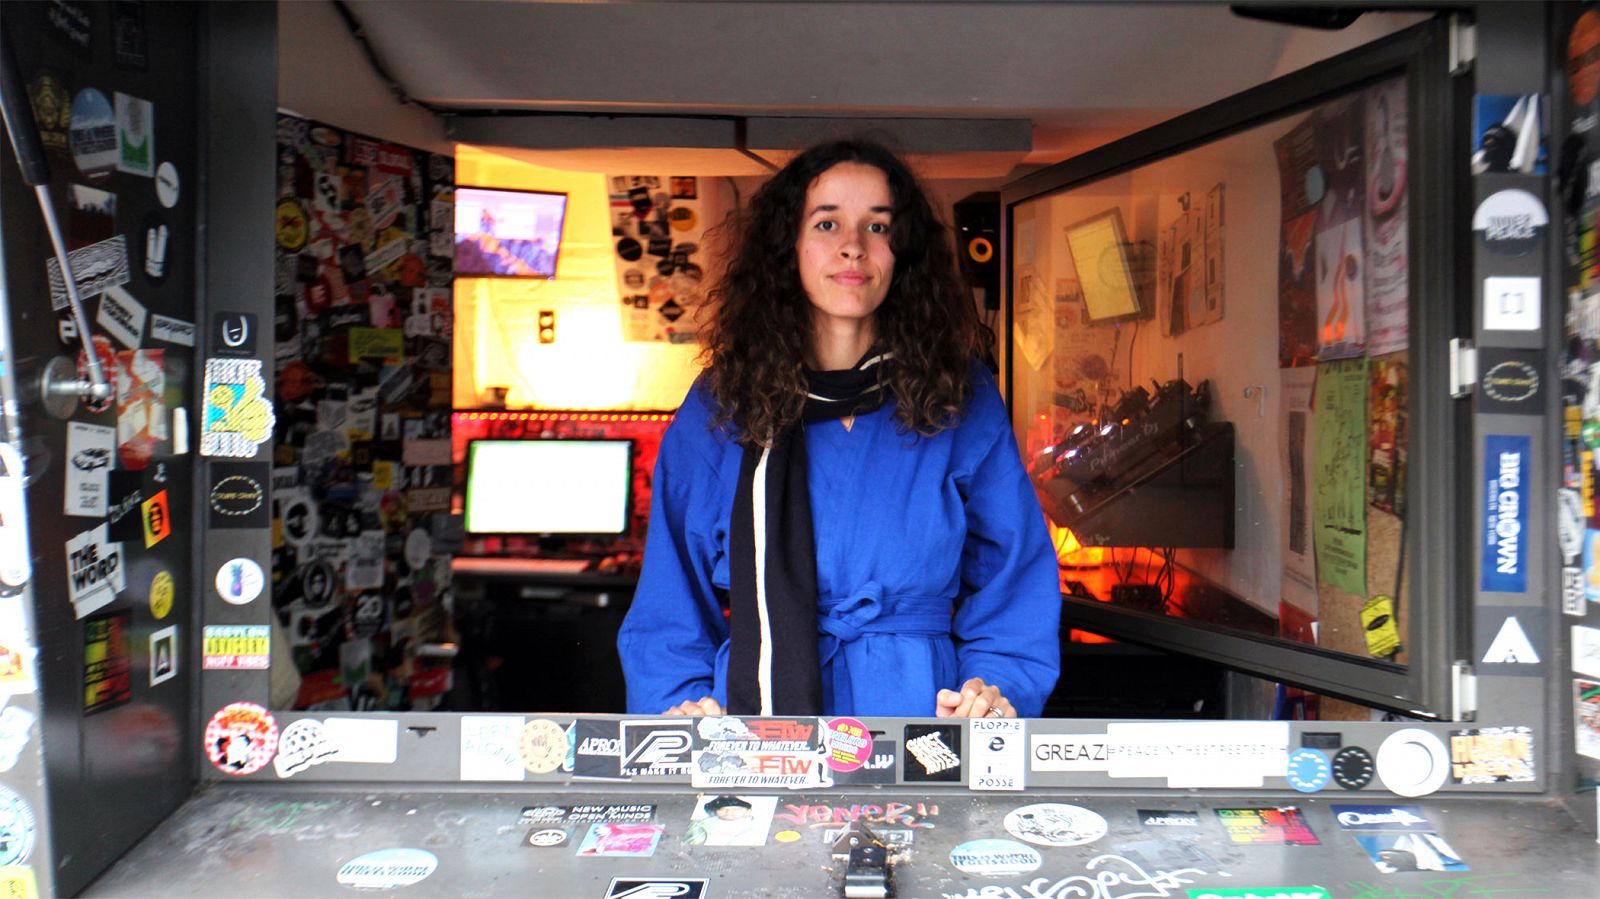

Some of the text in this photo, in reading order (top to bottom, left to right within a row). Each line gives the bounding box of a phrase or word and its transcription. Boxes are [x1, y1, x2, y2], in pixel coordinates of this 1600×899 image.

[1496, 490, 1521, 575] CROWN
[70, 543, 97, 568] THE
[73, 552, 119, 590] WORD
[577, 737, 621, 756] APRO
[748, 741, 759, 751] TO
[640, 767, 666, 775] MAKE
[756, 755, 812, 775] FTW
[708, 775, 746, 785] FOREVER
[748, 775, 759, 784] TO
[571, 805, 652, 813] NEW MUSIC
[607, 812, 651, 820] MINDS
